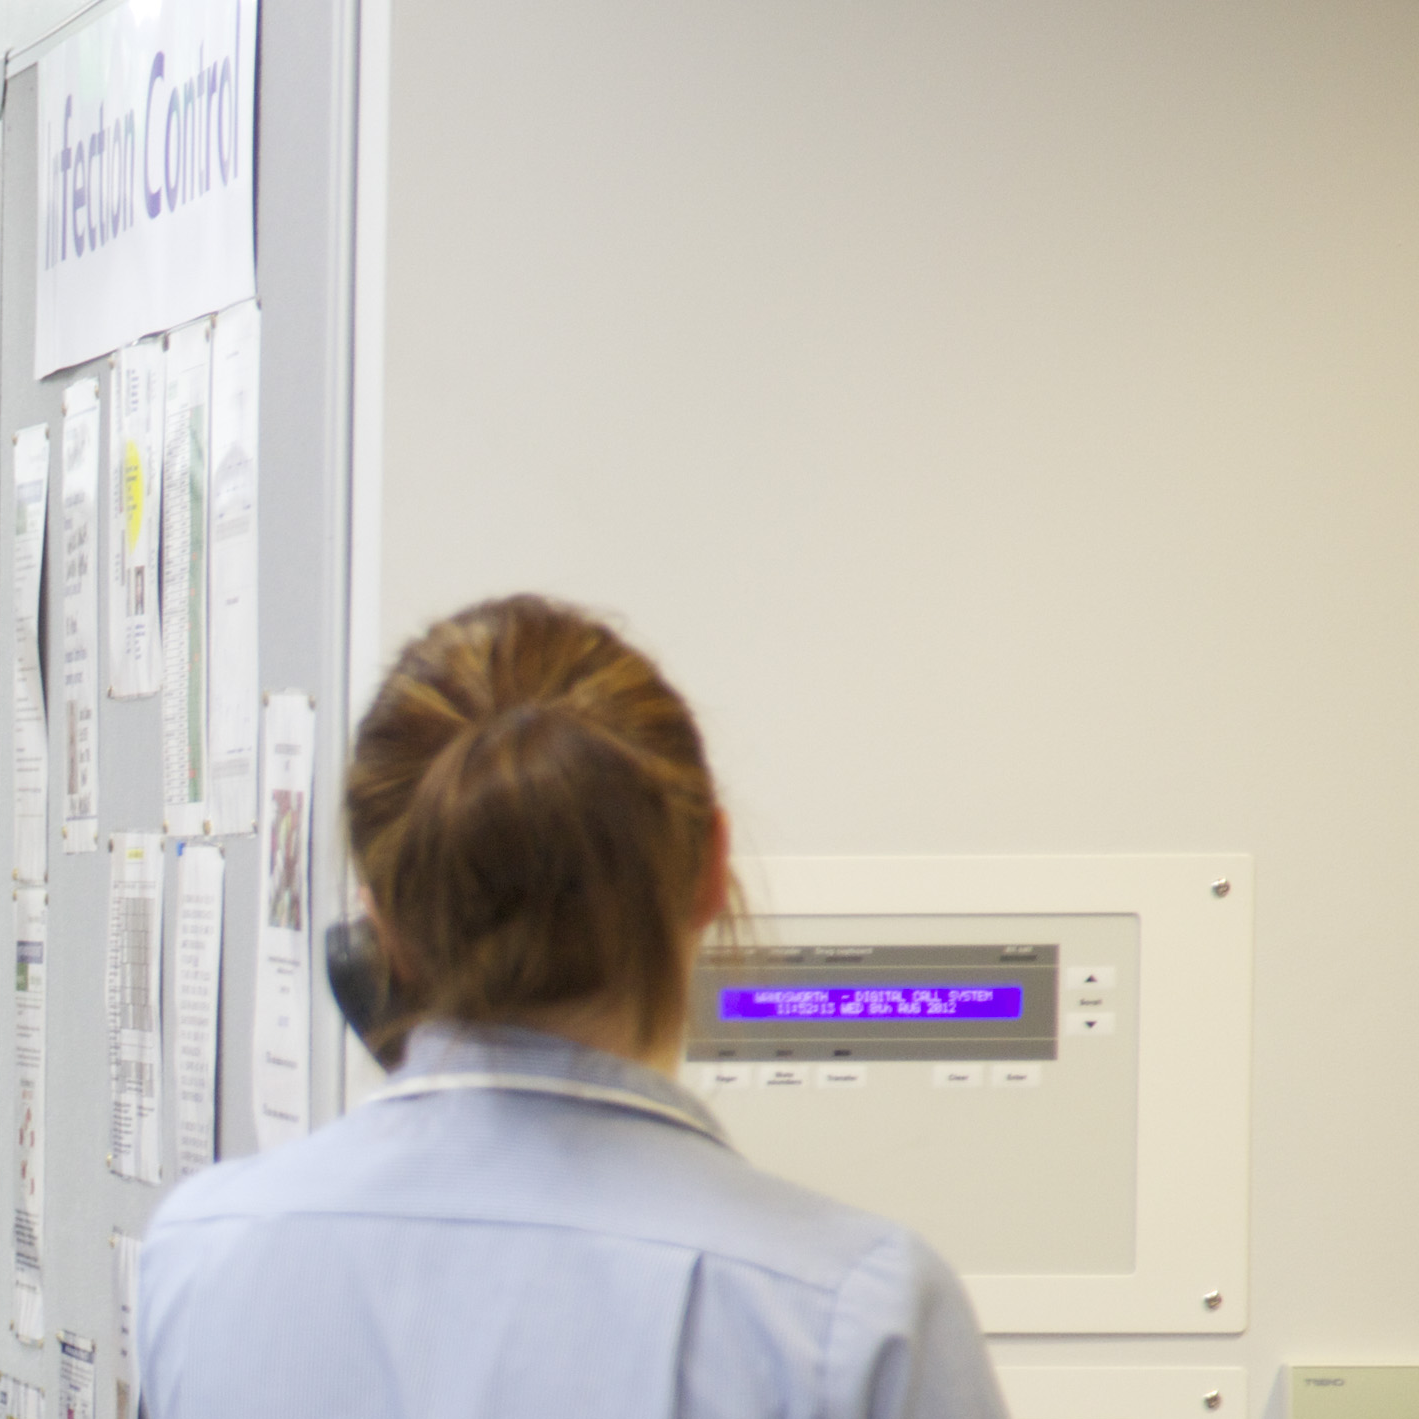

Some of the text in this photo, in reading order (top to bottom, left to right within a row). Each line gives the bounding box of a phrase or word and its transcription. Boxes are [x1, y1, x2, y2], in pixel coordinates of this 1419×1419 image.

[43, 0, 241, 271] Infection Control
[854, 990, 906, 1002] DIGITAL
[912, 990, 942, 1002] CALL
[948, 990, 994, 1002] SYSTEM
[927, 1001, 957, 1014] 2012
